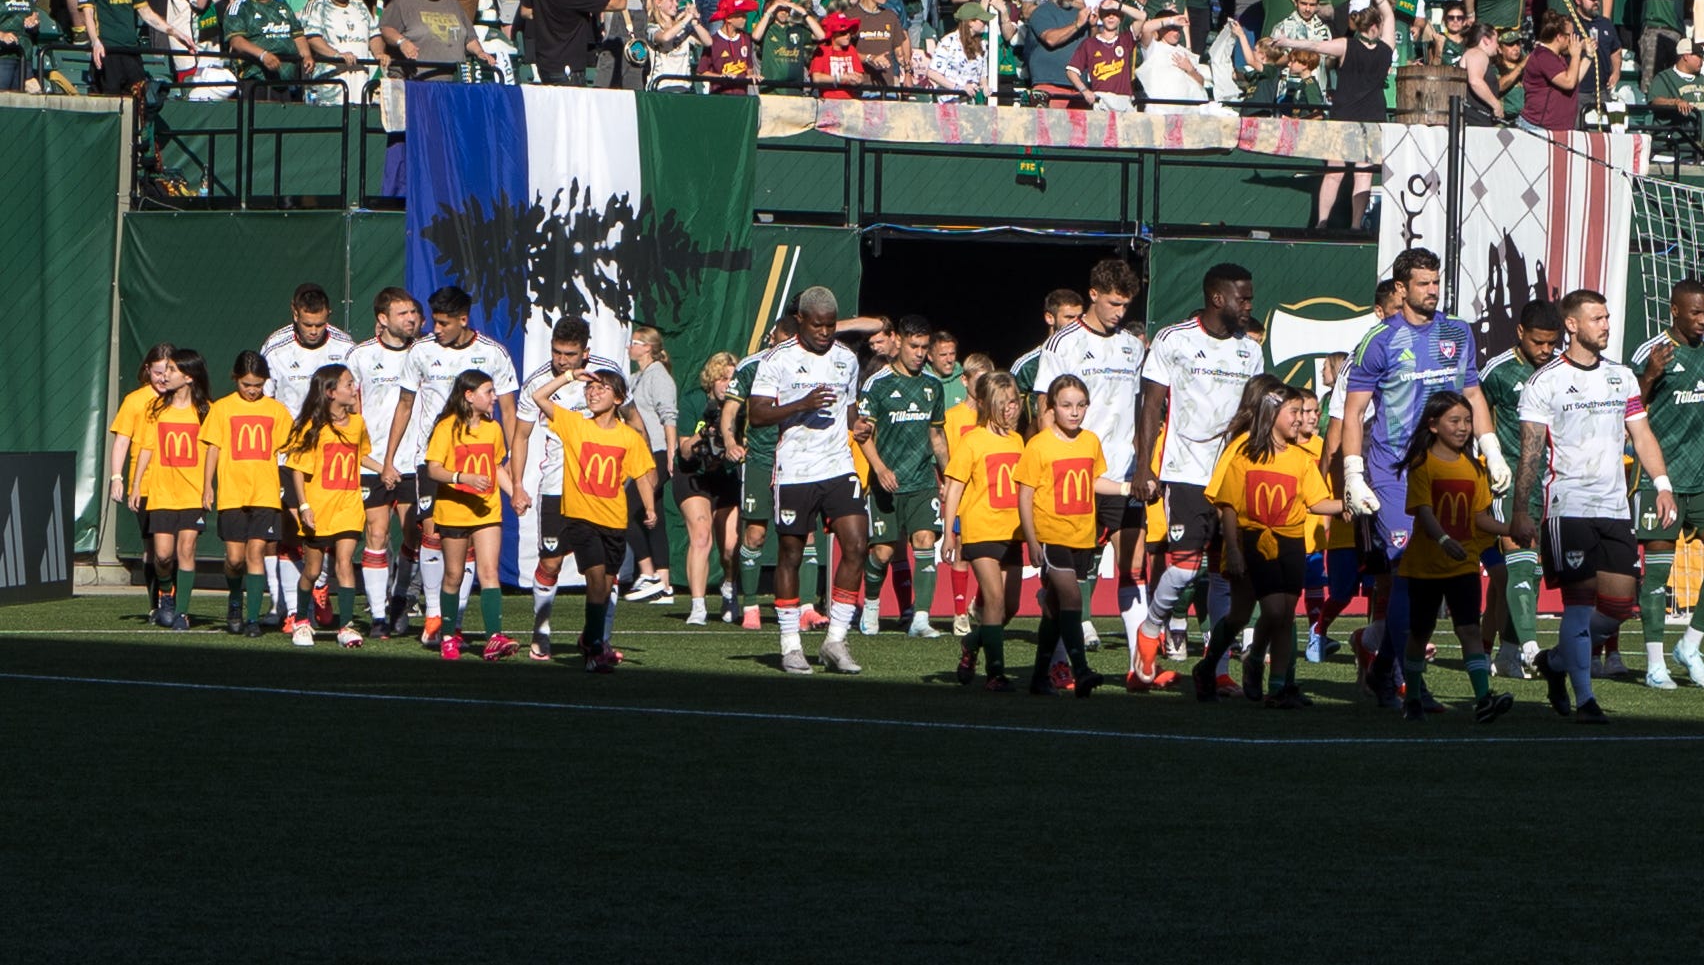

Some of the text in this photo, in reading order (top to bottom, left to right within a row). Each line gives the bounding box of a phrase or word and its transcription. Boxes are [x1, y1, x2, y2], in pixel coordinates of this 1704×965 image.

[262, 22, 291, 34] Alaska
[1093, 59, 1125, 81] Timbers
[1562, 397, 1627, 411] UT Southwestern
[848, 475, 861, 499] 7
